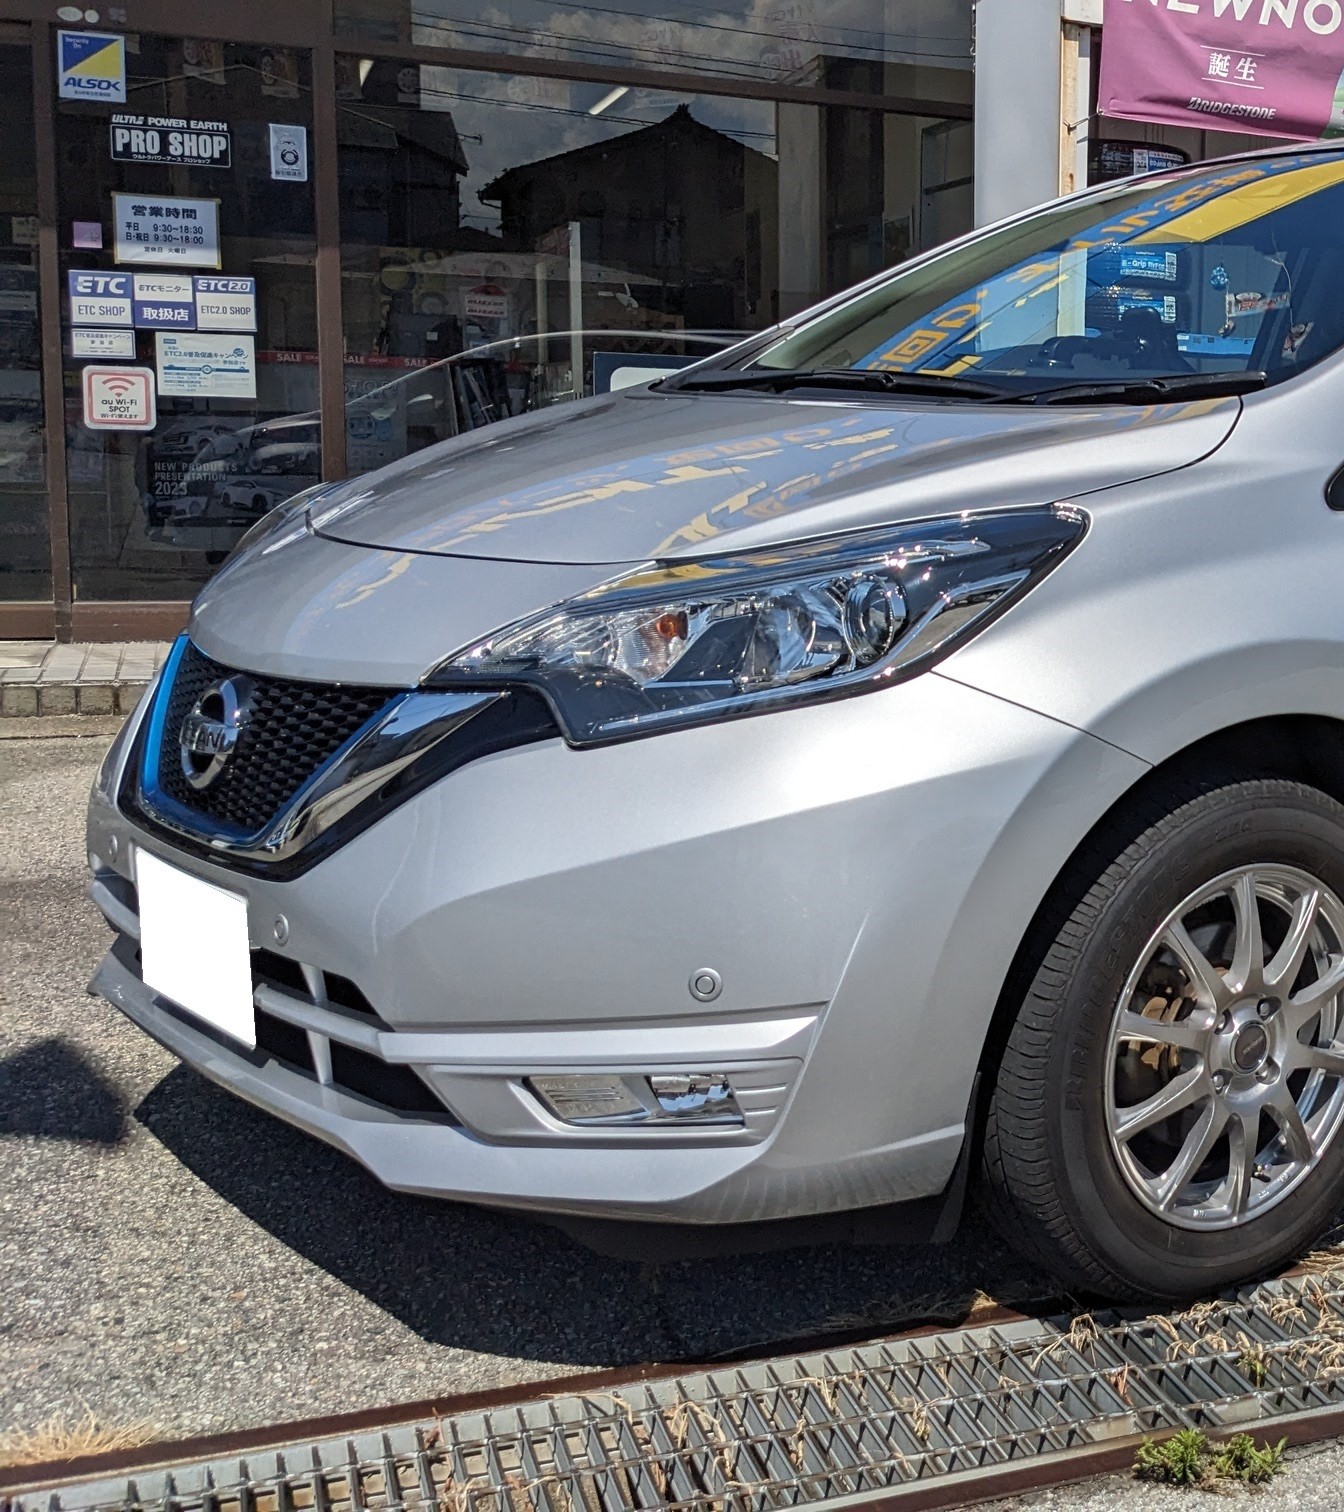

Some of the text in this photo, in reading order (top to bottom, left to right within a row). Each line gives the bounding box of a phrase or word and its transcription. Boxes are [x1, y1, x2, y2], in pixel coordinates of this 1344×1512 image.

[1121, 0, 1342, 35] WNO
[1208, 52, 1257, 81] 誕生
[64, 77, 121, 91] ALSOK
[1187, 97, 1277, 120] BRIDGESTONE
[112, 114, 227, 131] ULTRA POWER EARTH
[115, 128, 227, 158] PRO SHOP
[131, 205, 197, 220] 営業時間
[125, 222, 139, 231] 平日
[76, 276, 126, 294] ETC
[138, 284, 190, 293] ETCモニター
[78, 305, 125, 316] ETC SHOP
[142, 307, 189, 321] 取扱店
[201, 305, 251, 315] ETC2.0 SHOP
[277, 353, 301, 362] SALE
[154, 462, 176, 471] NEW
[154, 472, 226, 481] PRESENTATION
